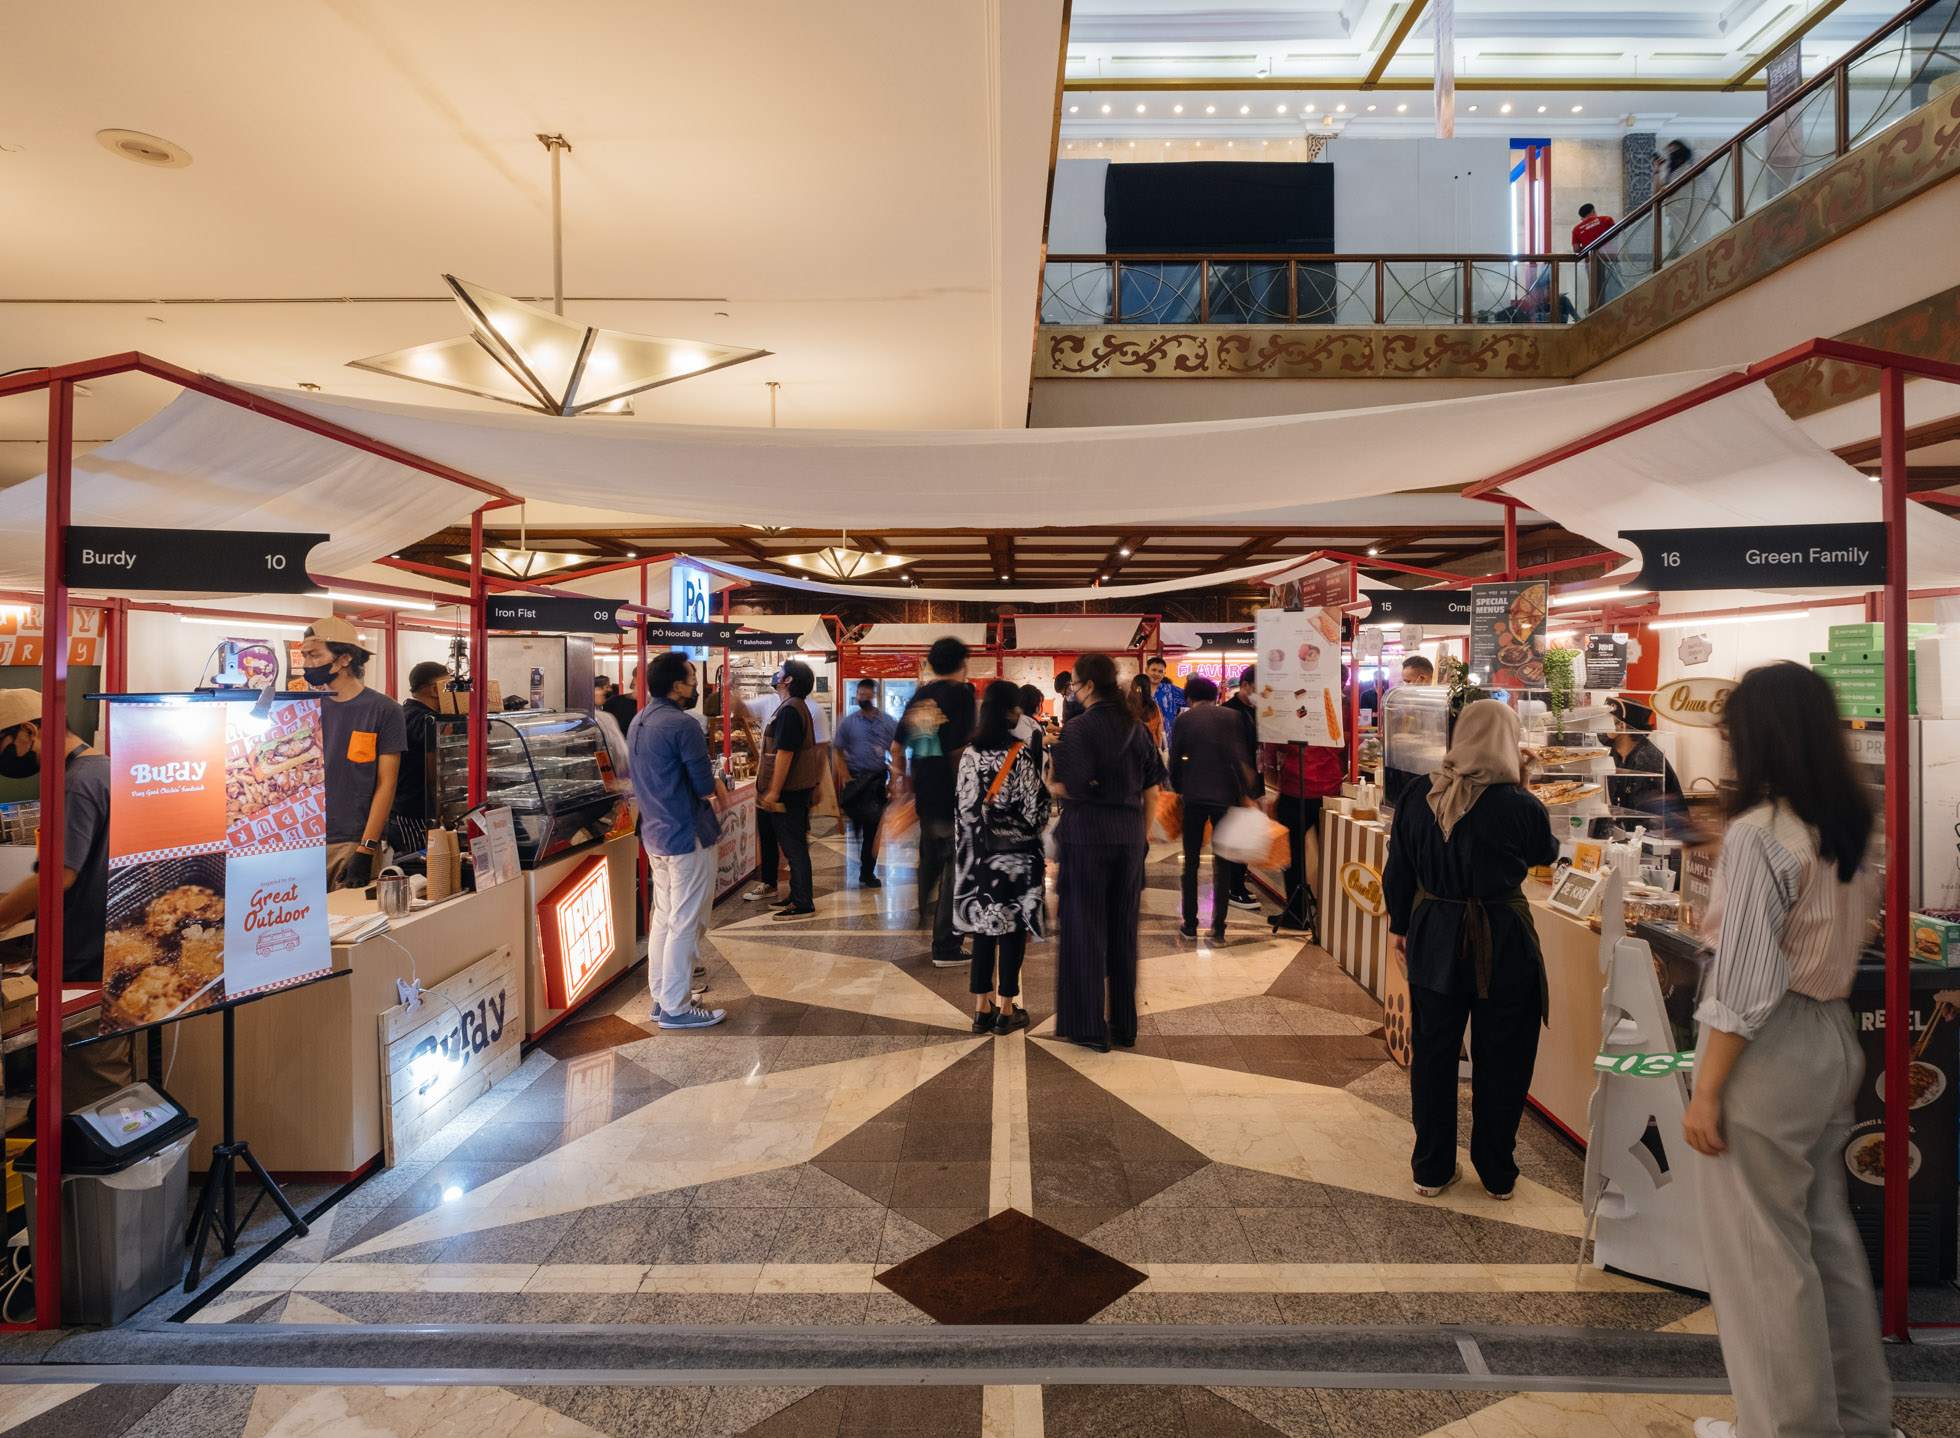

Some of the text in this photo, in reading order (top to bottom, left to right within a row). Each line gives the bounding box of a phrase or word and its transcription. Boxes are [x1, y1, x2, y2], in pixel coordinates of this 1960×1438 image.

[81, 549, 287, 570] Burdy 10
[1660, 547, 1869, 567] 16 Green Family
[1381, 602, 1471, 612] 15 Oma
[1475, 597, 1509, 606] SPECIAL
[1475, 605, 1505, 614] MENUS
[495, 607, 609, 620] Iron Fist 09
[665, 630, 690, 638] Noodle
[691, 630, 704, 638] Bar
[130, 760, 207, 784] Burdy
[1580, 857, 1596, 866] THANK
[250, 883, 298, 913] Great
[1560, 882, 1590, 901] BE KIND
[244, 906, 310, 932] Outdoor
[564, 877, 606, 948] IRON
[568, 911, 610, 987] FIST
